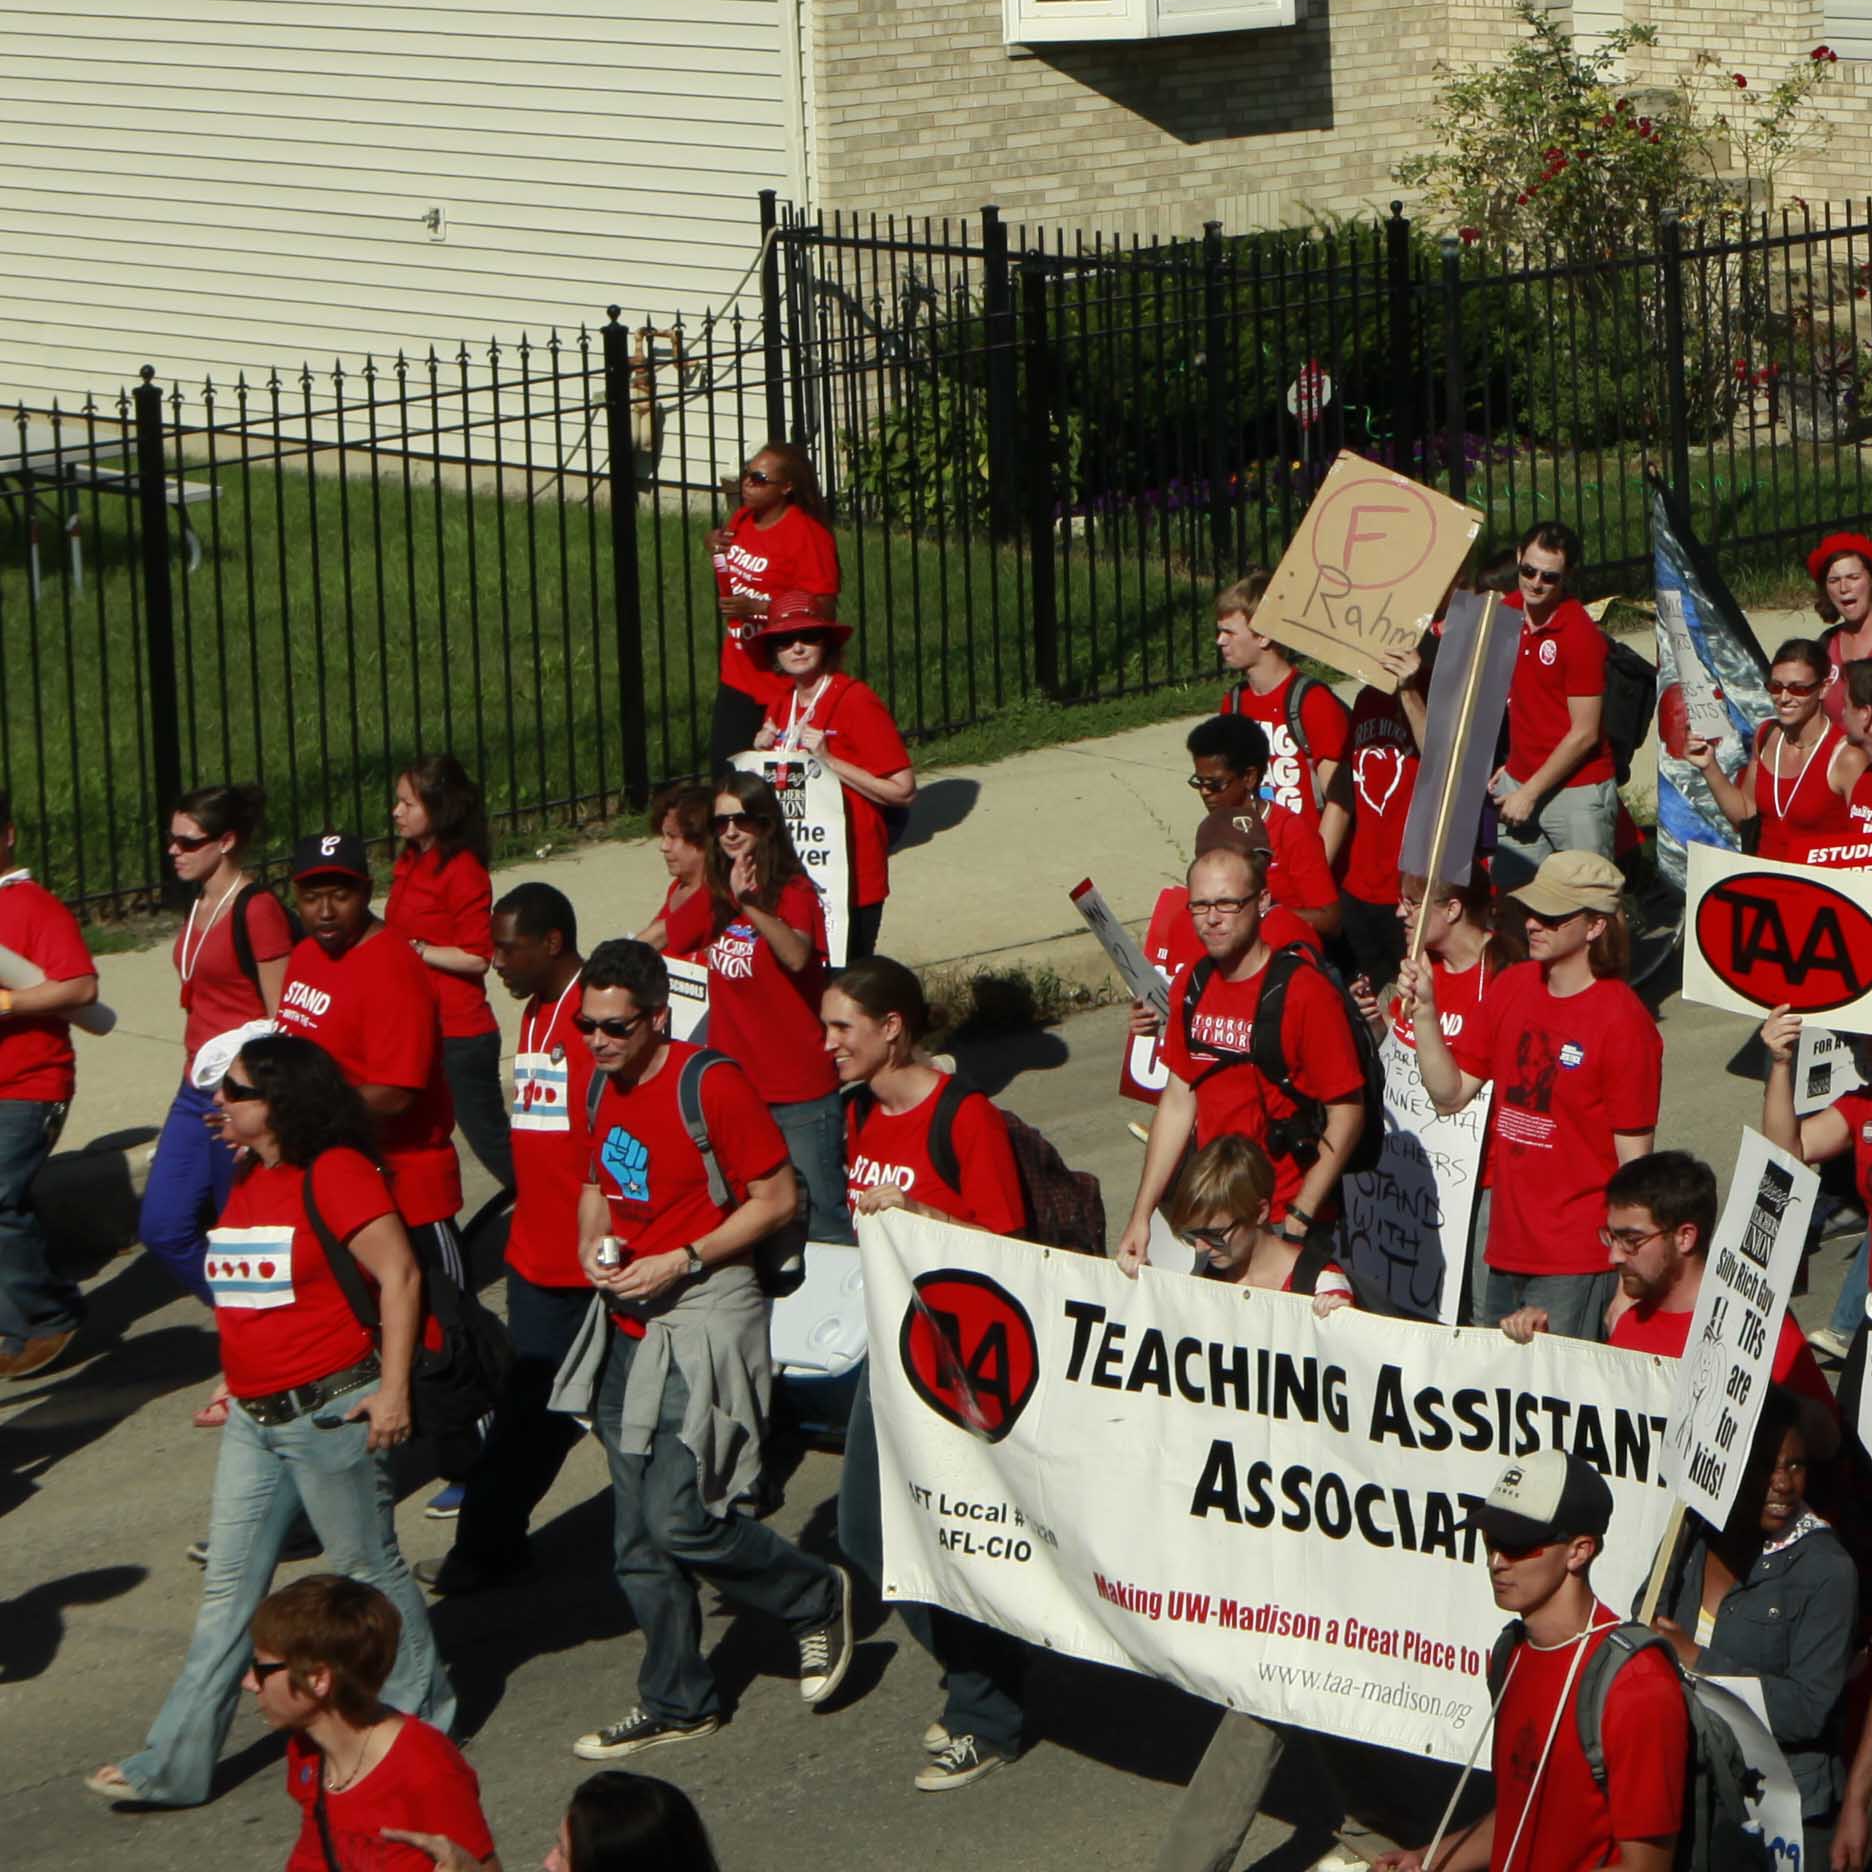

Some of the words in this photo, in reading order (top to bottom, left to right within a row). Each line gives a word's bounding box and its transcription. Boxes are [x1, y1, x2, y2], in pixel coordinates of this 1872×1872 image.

[1344, 505, 1411, 572] F
[1717, 885, 1863, 996] TAA
[283, 981, 331, 1016] STAND
[847, 1154, 915, 1192] STAND
[1716, 1247, 1738, 1282] Silly
[1736, 1256, 1760, 1303] Rich
[1752, 1272, 1775, 1315] Guy
[1738, 1310, 1766, 1357] TIFs
[1064, 1299, 1350, 1432] TEACHING
[1727, 1364, 1750, 1406] are
[1714, 1407, 1738, 1445] for
[1688, 1442, 1727, 1500] kids!
[939, 1493, 1007, 1524] Local
[1190, 1439, 1483, 1564] ASSOCIAT
[938, 1527, 1033, 1563] AFL-CIO
[1092, 1571, 1163, 1620] Making
[1167, 1590, 1321, 1642] UW-Madison
[1343, 1617, 1399, 1658] Great
[1403, 1630, 1456, 1671] Place
[1460, 1646, 1480, 1677] to
[1256, 1659, 1473, 1730] www.taa-madison.org
